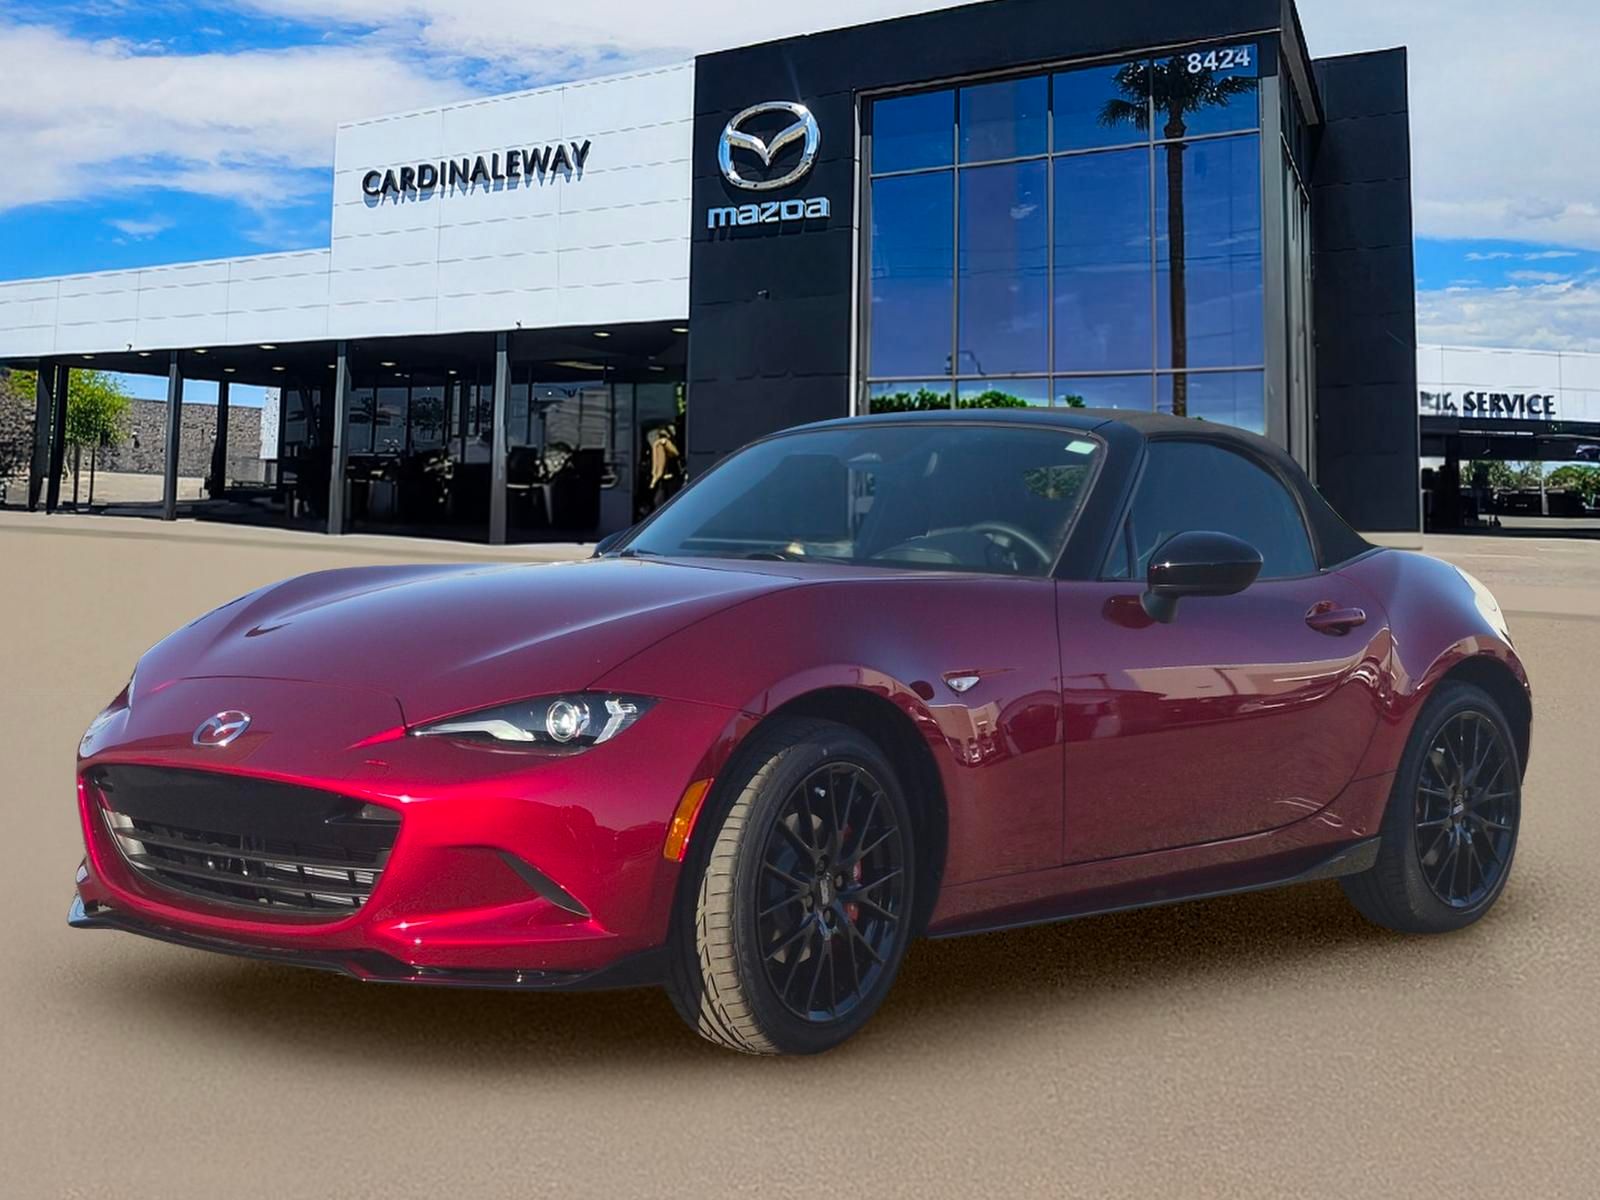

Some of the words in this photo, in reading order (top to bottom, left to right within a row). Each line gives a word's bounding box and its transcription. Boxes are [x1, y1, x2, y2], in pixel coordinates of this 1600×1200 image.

[1187, 47, 1251, 74] 8424
[362, 139, 591, 196] CARDINALEWAY
[707, 196, 831, 229] mazda
[1463, 391, 1556, 415] SERVICE
